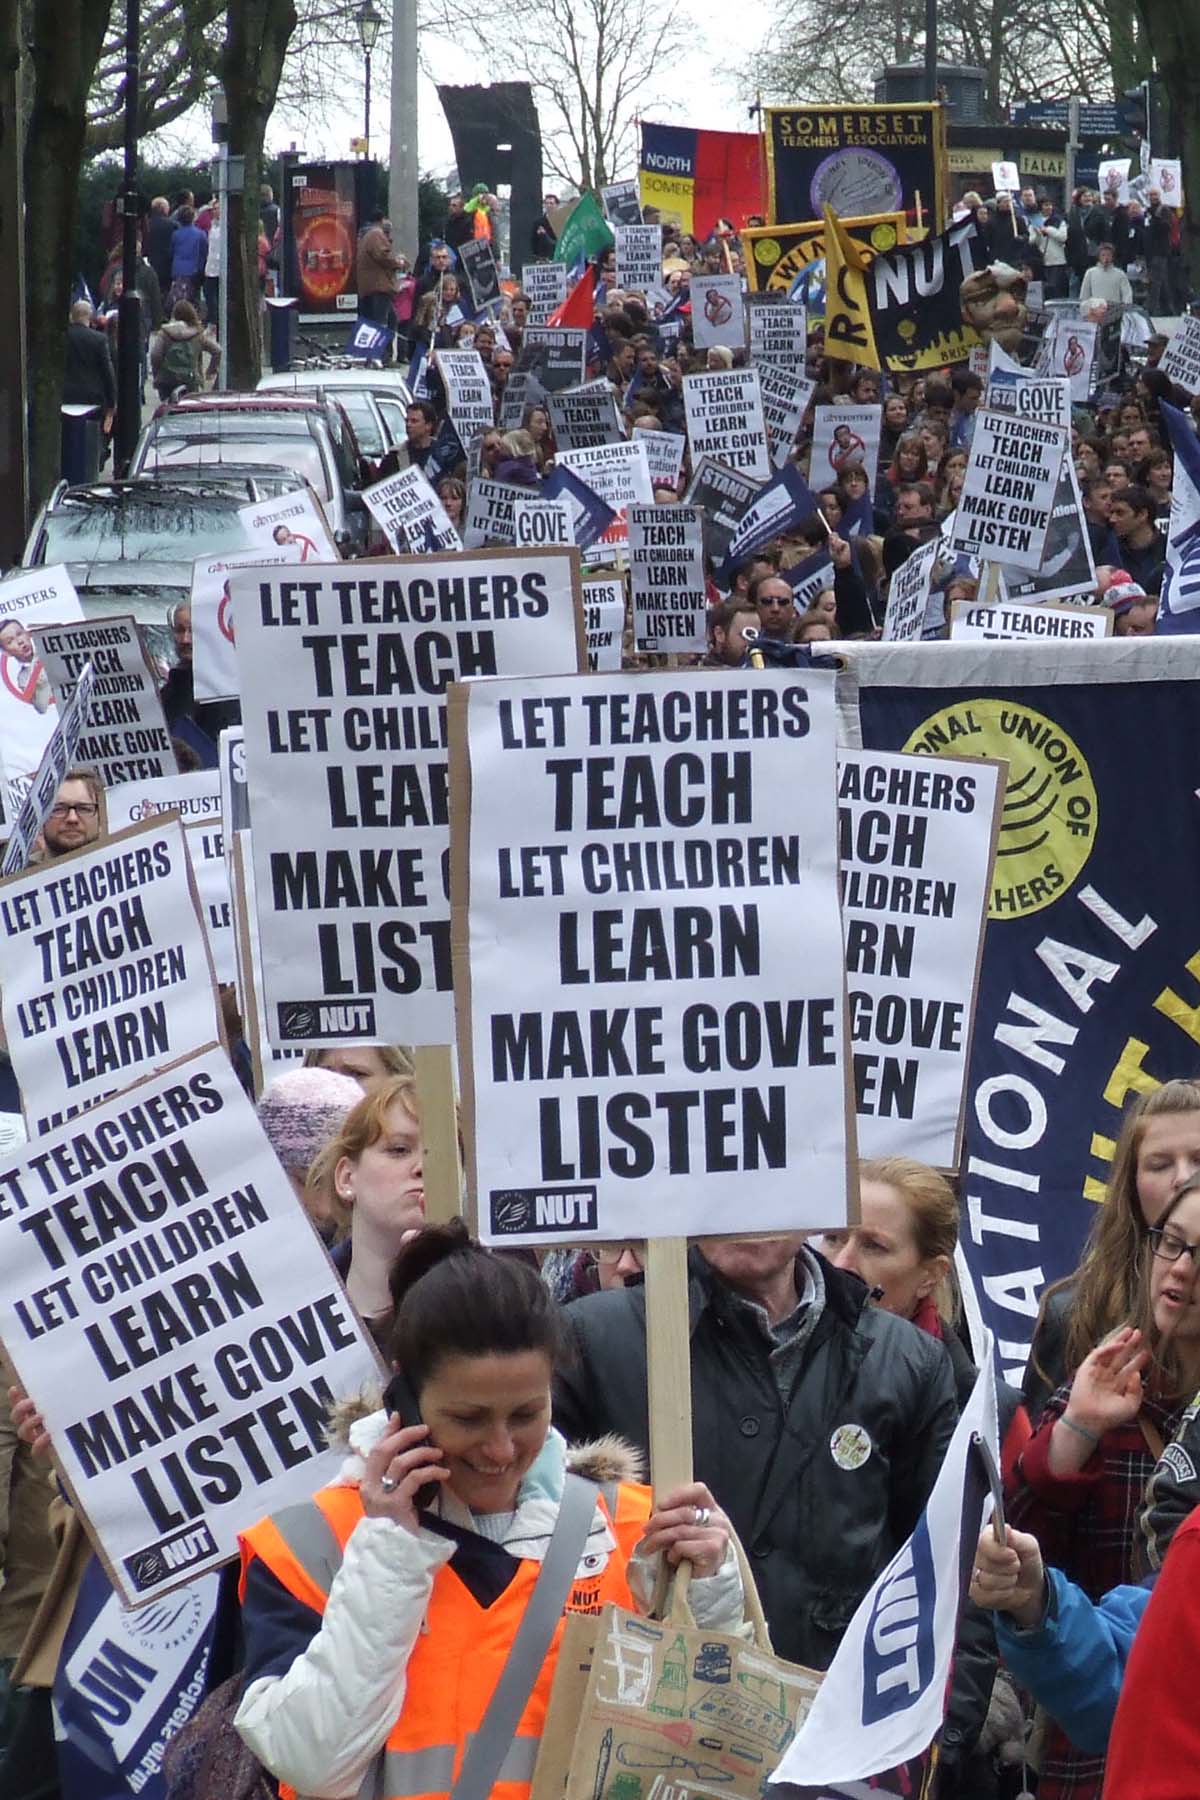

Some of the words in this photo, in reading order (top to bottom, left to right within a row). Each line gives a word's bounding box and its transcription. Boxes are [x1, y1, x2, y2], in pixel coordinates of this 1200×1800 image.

[780, 115, 923, 134] SOMERSET
[781, 135, 840, 147] TEACHERS
[847, 133, 927, 146] ASSOCIATION
[646, 153, 691, 172] NORTH
[1024, 157, 1064, 173] FALAF
[623, 273, 655, 284] LISTEN
[874, 222, 978, 309] NUT
[762, 318, 793, 328] TEACH
[528, 334, 565, 347] STAND
[567, 333, 583, 346] UP
[763, 340, 793, 351] LEARN
[450, 365, 477, 377] TEACH
[689, 378, 705, 389] LET
[706, 373, 754, 388] TEACHERS
[1165, 363, 1198, 386] LISTEN
[458, 389, 482, 402] LEARN
[700, 386, 744, 404] TEACH
[759, 376, 796, 400] TEACH
[991, 389, 1016, 405] STA
[1019, 387, 1065, 411] GOVE
[564, 408, 600, 423] TEACH
[692, 406, 707, 418] LET
[708, 401, 754, 416] CHILDREN
[705, 416, 747, 433] LEARN
[983, 416, 1003, 432] LET
[1004, 422, 1059, 446] TEACHERS
[564, 452, 584, 465] LET
[586, 444, 640, 462] TEACHERS
[570, 434, 606, 448] LEARN
[693, 437, 730, 453] MAKE
[732, 431, 764, 448] GOVE
[992, 435, 1043, 464] TEACH
[617, 475, 633, 487] for
[975, 454, 996, 470] LET
[996, 458, 1050, 482] CHILDREN
[368, 492, 382, 504] LET
[381, 471, 418, 498] TEACHERS
[478, 483, 496, 498] LET
[702, 468, 750, 503] STAND
[984, 474, 1035, 502] LEARN
[383, 488, 420, 516] TEACH
[487, 499, 515, 519] TEA
[632, 509, 648, 524] LET
[650, 508, 696, 523] TEACHERS
[962, 496, 1008, 520] MAKE
[1009, 504, 1048, 530] GOVE
[473, 516, 489, 529] LET
[492, 521, 515, 537] CHIL
[518, 511, 568, 542] GOVE
[642, 525, 685, 545] TEACH
[968, 519, 1031, 552] LISTEN
[633, 550, 649, 562] LET
[649, 548, 694, 562] CHILDREN
[648, 566, 688, 586] LEARN
[0, 586, 58, 614] BUSTERS
[259, 582, 323, 626] LET
[332, 572, 549, 624] TEACHERS
[635, 592, 669, 611] MAKE
[670, 591, 704, 610] GOVE
[646, 614, 696, 637] LISTEN
[966, 608, 997, 626] LET
[1001, 610, 1094, 639] TEACHERS
[42, 635, 65, 654] LET
[65, 626, 131, 651] TEACHERS
[302, 630, 498, 697] TEACH
[92, 674, 145, 697] HILDREN
[87, 698, 141, 728] LEARN
[500, 696, 571, 749] LET
[582, 686, 811, 745] TEACHERS
[76, 734, 124, 762] MAKE
[126, 727, 170, 755] GOVE
[267, 709, 332, 753] LET
[1000, 711, 1083, 785] UNION
[1066, 796, 1091, 837] OF
[546, 751, 752, 832] TEACH
[838, 763, 976, 814] ACHERS
[270, 849, 427, 911] MAKE
[498, 845, 568, 898] LET
[581, 835, 800, 894] CHILDREN
[2, 889, 41, 937] LET
[43, 840, 172, 920] TEACHERS
[34, 895, 152, 984] TEACH
[559, 903, 760, 985] LEARN
[318, 920, 453, 995] LIST
[16, 992, 57, 1039] LET
[62, 945, 187, 1022] CHILDREN
[319, 1005, 371, 1033] NUT
[851, 991, 963, 1052] GOVE
[56, 1000, 169, 1089] LEARN
[490, 1007, 665, 1082] MAKE
[682, 998, 836, 1072] GOVE
[0, 1167, 29, 1221] ET
[28, 1071, 225, 1196] TEACHERS
[539, 1085, 787, 1182] LISTEN
[18, 1139, 209, 1271] TEACH
[535, 1193, 593, 1225] NUT
[13, 1276, 80, 1341] LET
[80, 1183, 270, 1305] CHILDREN
[84, 1250, 264, 1382] LEARN
[64, 1363, 218, 1480] MAKE
[213, 1292, 357, 1402] GOVE
[131, 1376, 335, 1534] LISTEN
[160, 1528, 214, 1570] NUT
[572, 1590, 599, 1606] NUT
